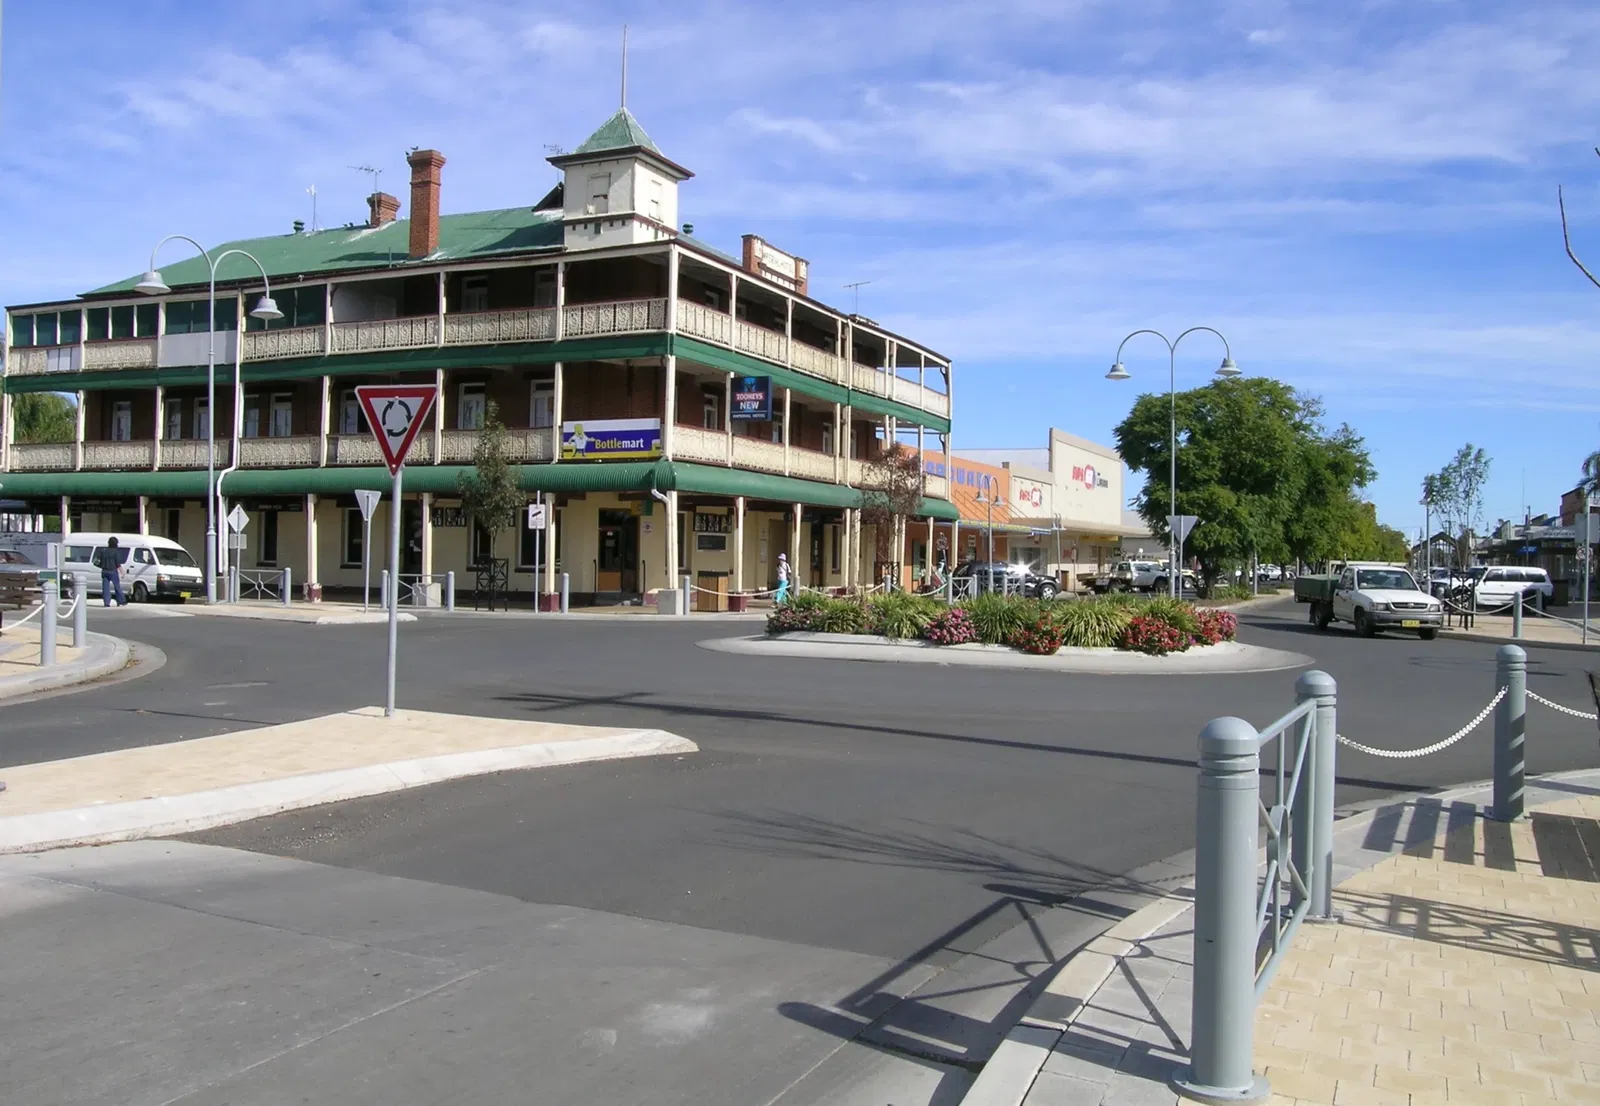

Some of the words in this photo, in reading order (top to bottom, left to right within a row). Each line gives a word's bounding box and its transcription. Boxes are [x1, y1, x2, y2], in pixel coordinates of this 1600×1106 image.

[735, 392, 764, 401] TOOHEYS
[739, 401, 759, 410] NEW
[594, 437, 644, 449] Bottlemart
